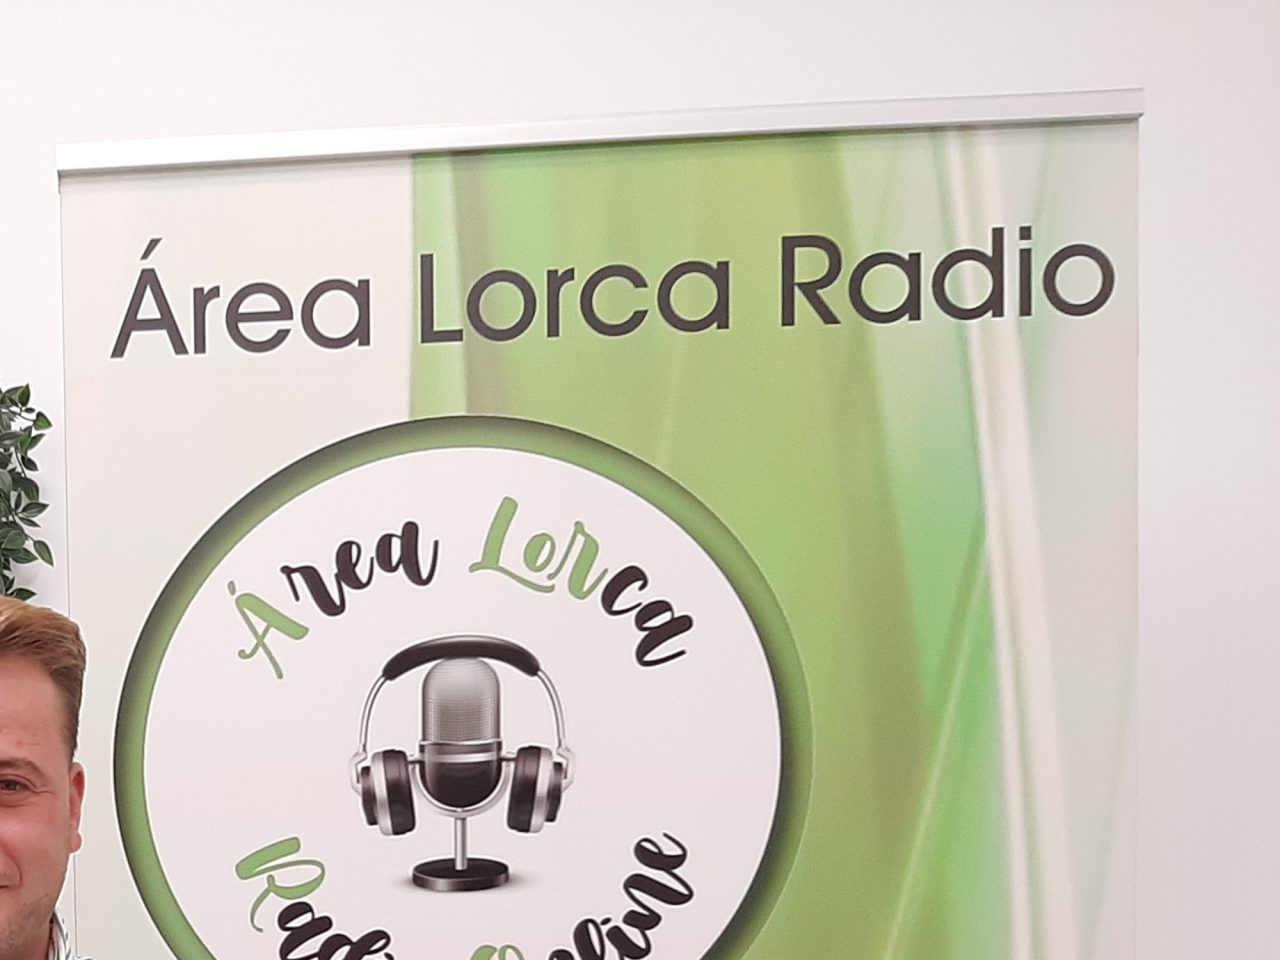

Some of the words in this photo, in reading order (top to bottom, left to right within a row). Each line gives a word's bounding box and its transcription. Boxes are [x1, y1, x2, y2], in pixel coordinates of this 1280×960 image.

[110, 237, 372, 359] Área
[418, 252, 732, 344] Lorca
[780, 225, 1116, 328] Radio
[227, 520, 440, 680] Área
[468, 496, 694, 667] Lorca
